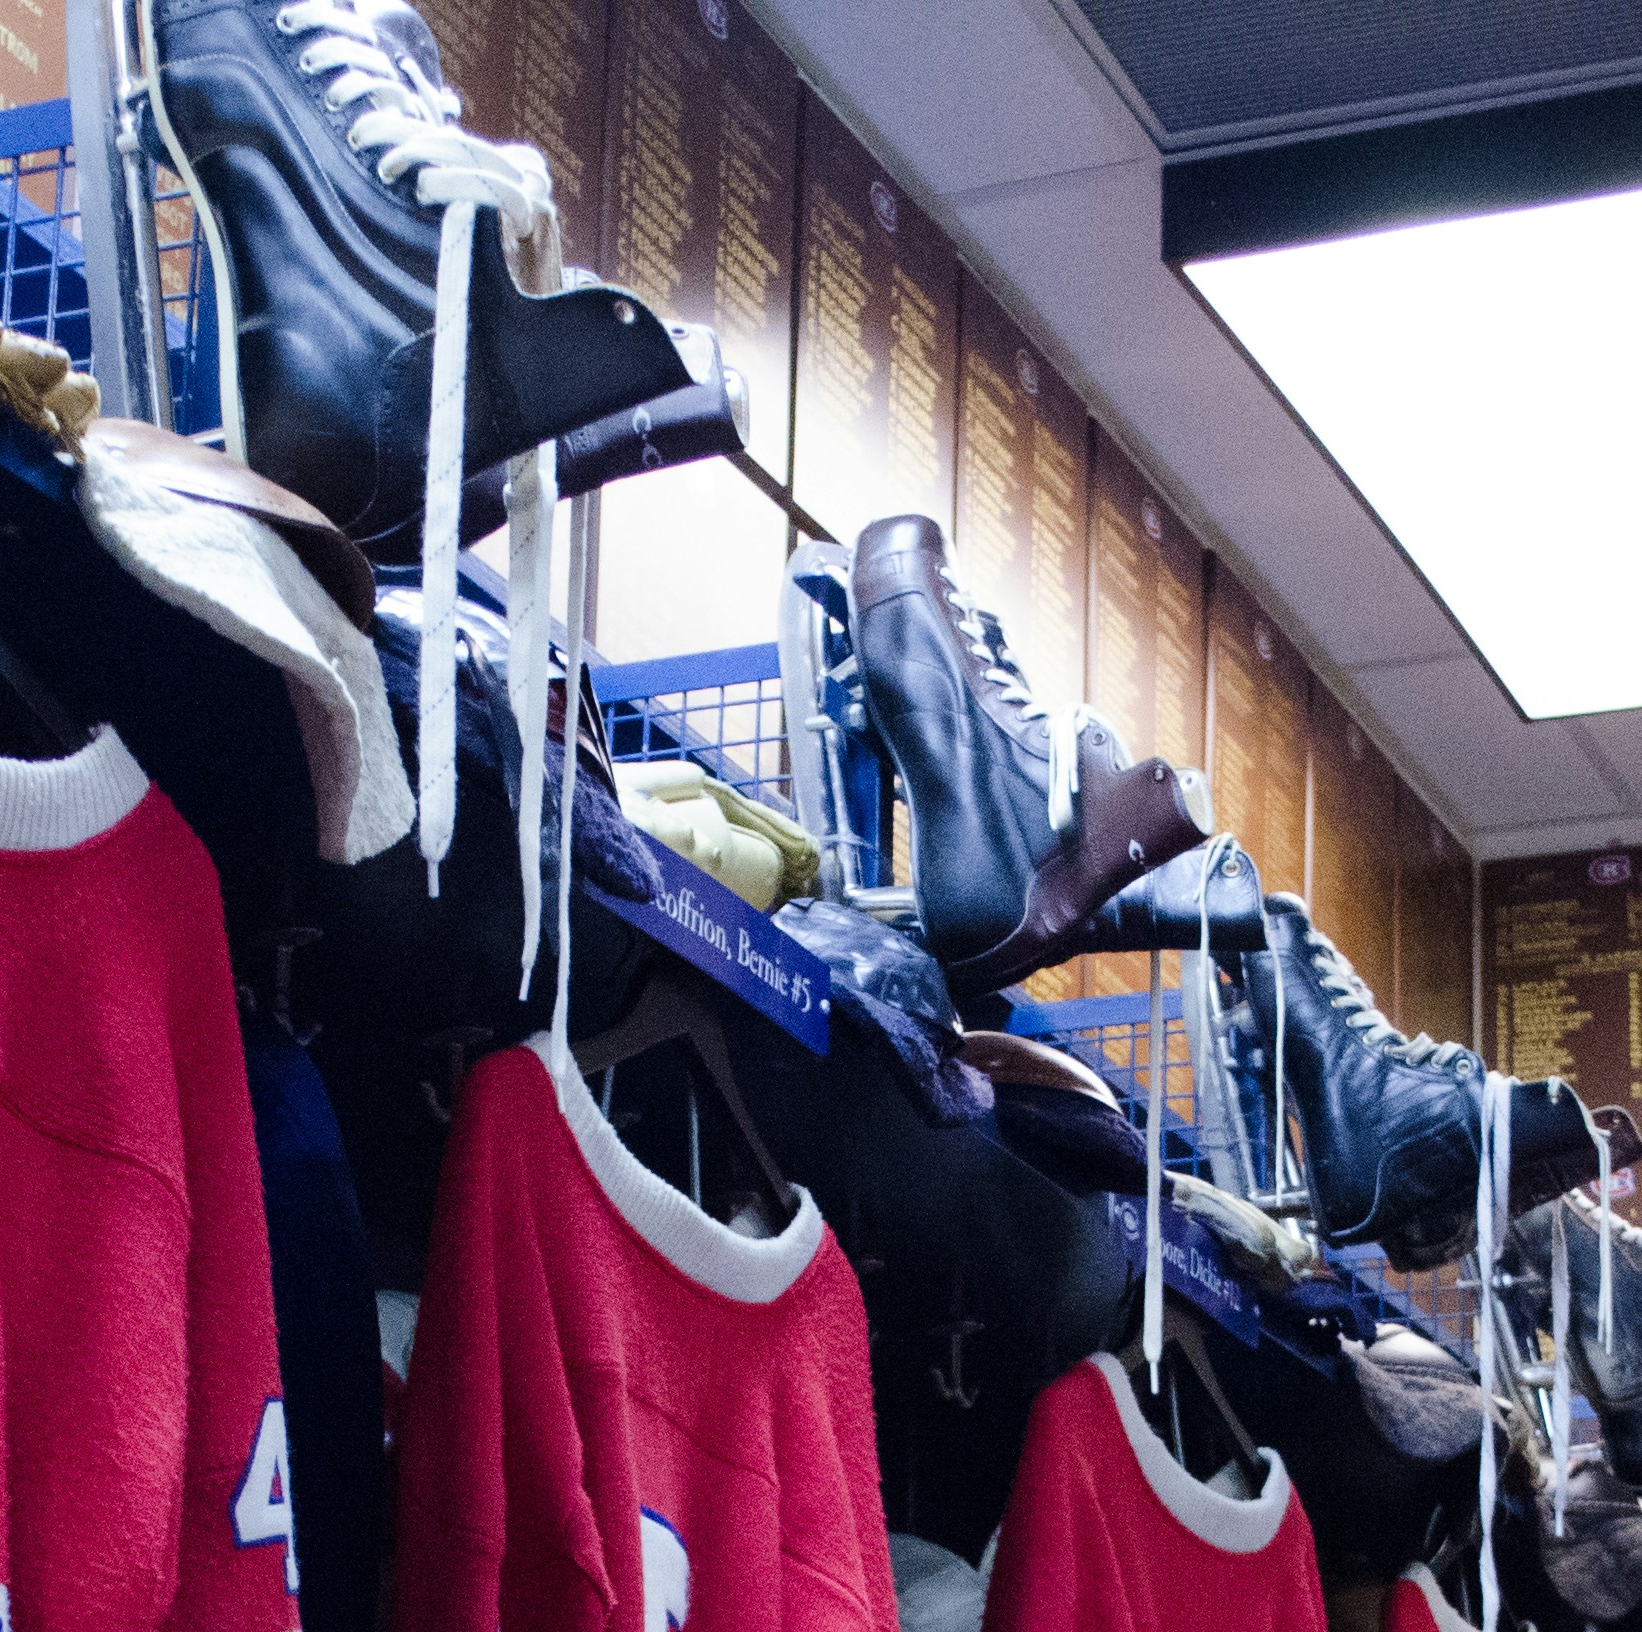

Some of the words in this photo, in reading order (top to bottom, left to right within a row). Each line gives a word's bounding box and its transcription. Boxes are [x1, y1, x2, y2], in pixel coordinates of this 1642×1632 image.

[650, 887, 733, 961] eoffrion,
[737, 926, 790, 996] Bernie
[791, 971, 813, 1014] #5
[228, 1396, 301, 1594] 4
